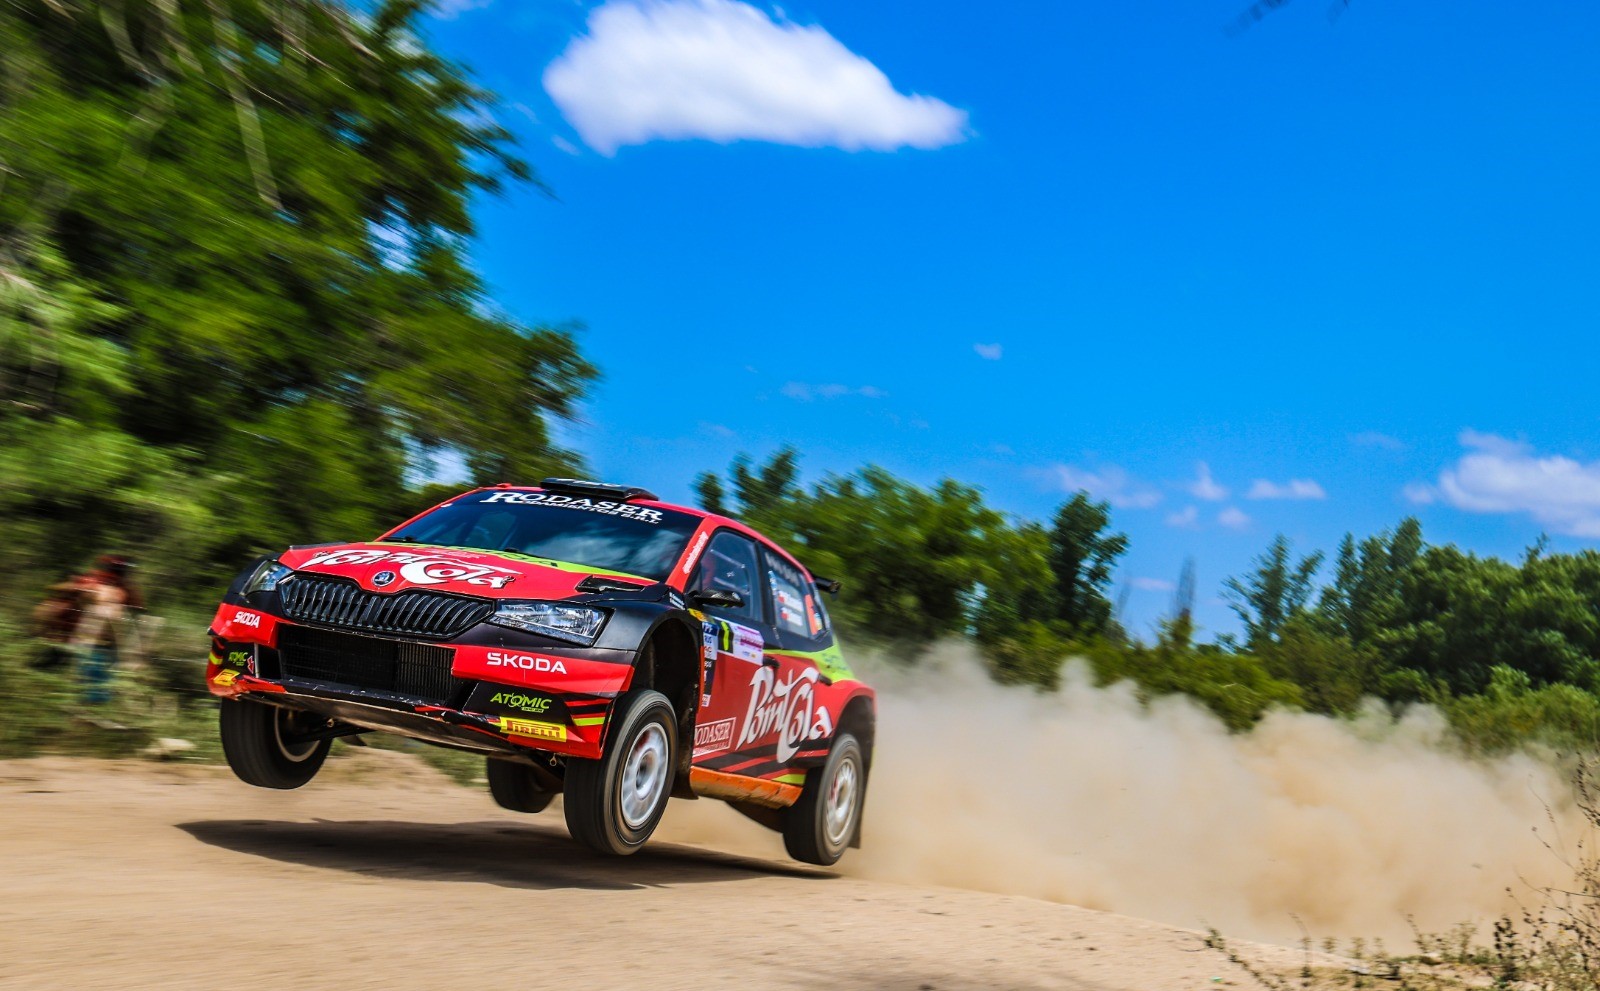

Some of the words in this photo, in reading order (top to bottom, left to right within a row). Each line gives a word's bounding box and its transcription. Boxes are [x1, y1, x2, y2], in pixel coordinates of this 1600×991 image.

[480, 491, 663, 521] RODASER
[233, 611, 261, 628] SKODA
[486, 651, 568, 675] SKODA
[490, 692, 553, 710] ATOMIC
[506, 719, 561, 739] PIRELLI
